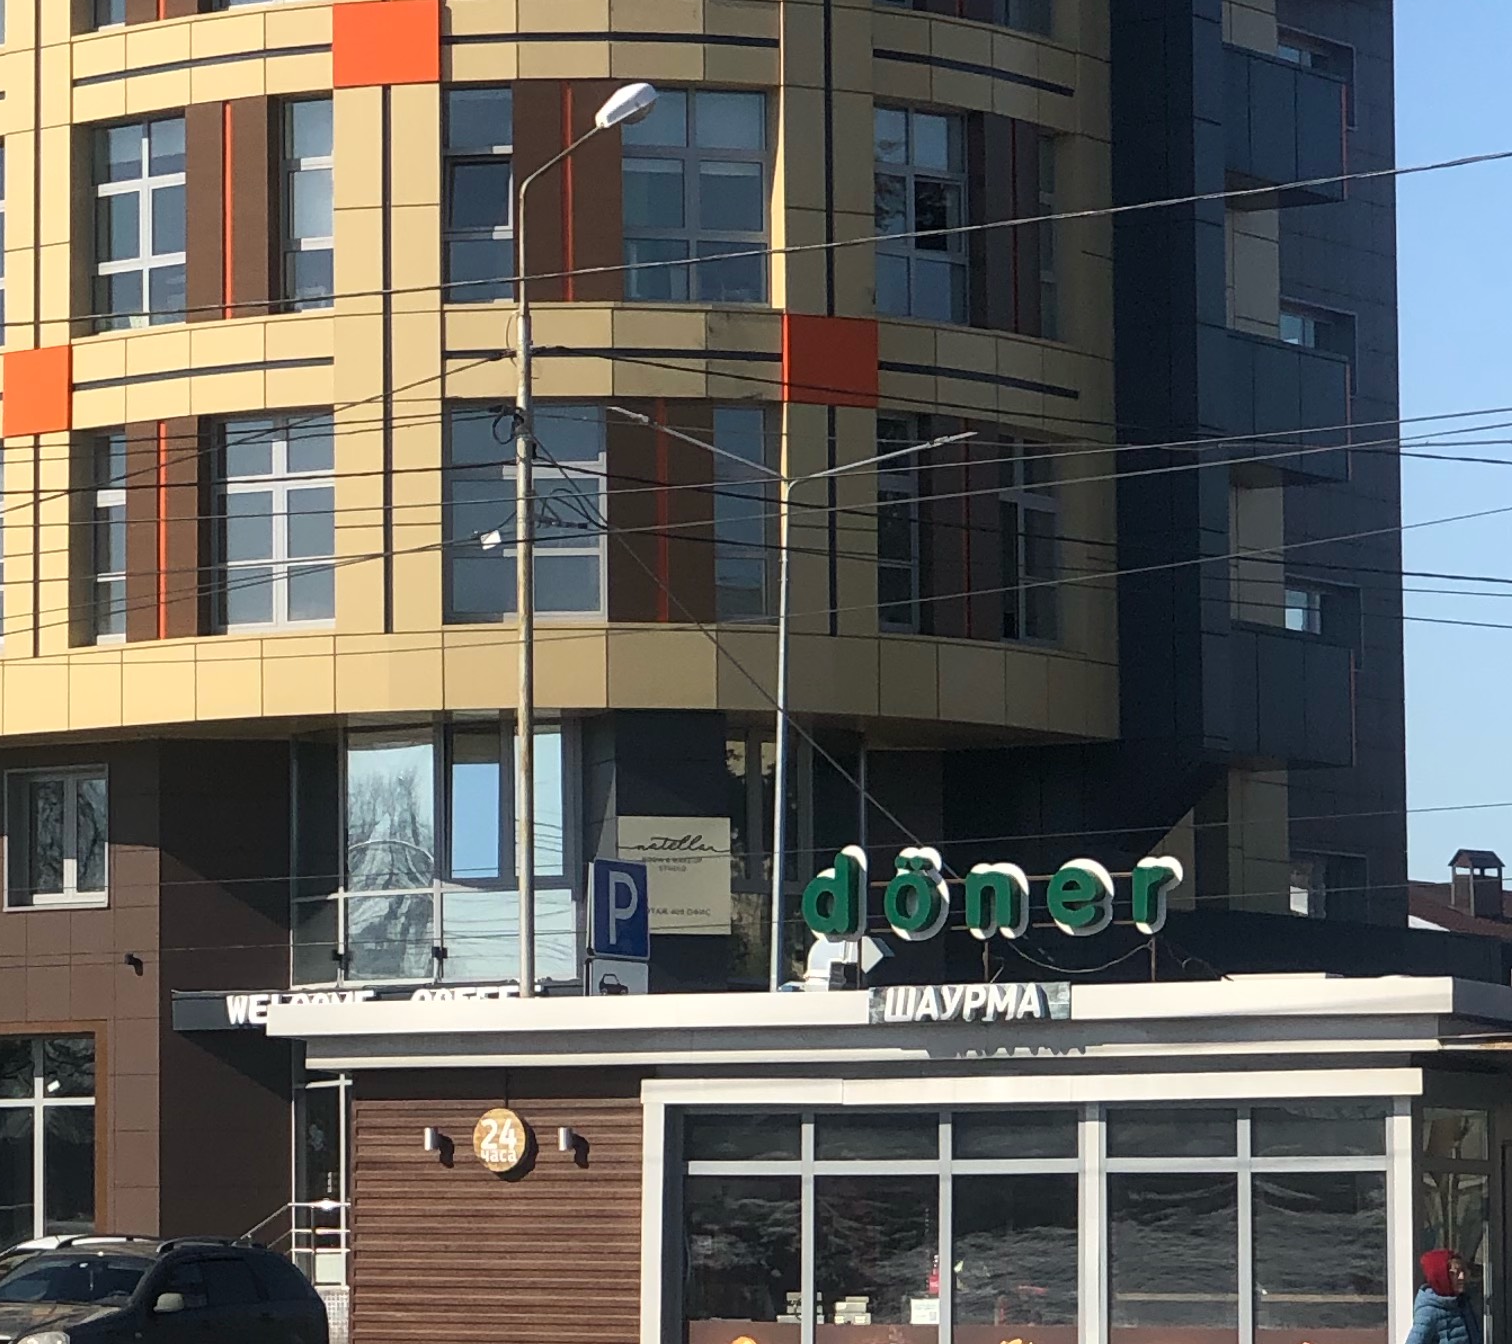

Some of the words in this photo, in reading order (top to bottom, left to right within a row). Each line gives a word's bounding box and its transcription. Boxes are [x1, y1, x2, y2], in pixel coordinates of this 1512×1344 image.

[609, 871, 638, 945] P
[884, 983, 1041, 1022] ШАУРМА
[481, 1119, 517, 1149] 24
[481, 1148, 517, 1162] часа
